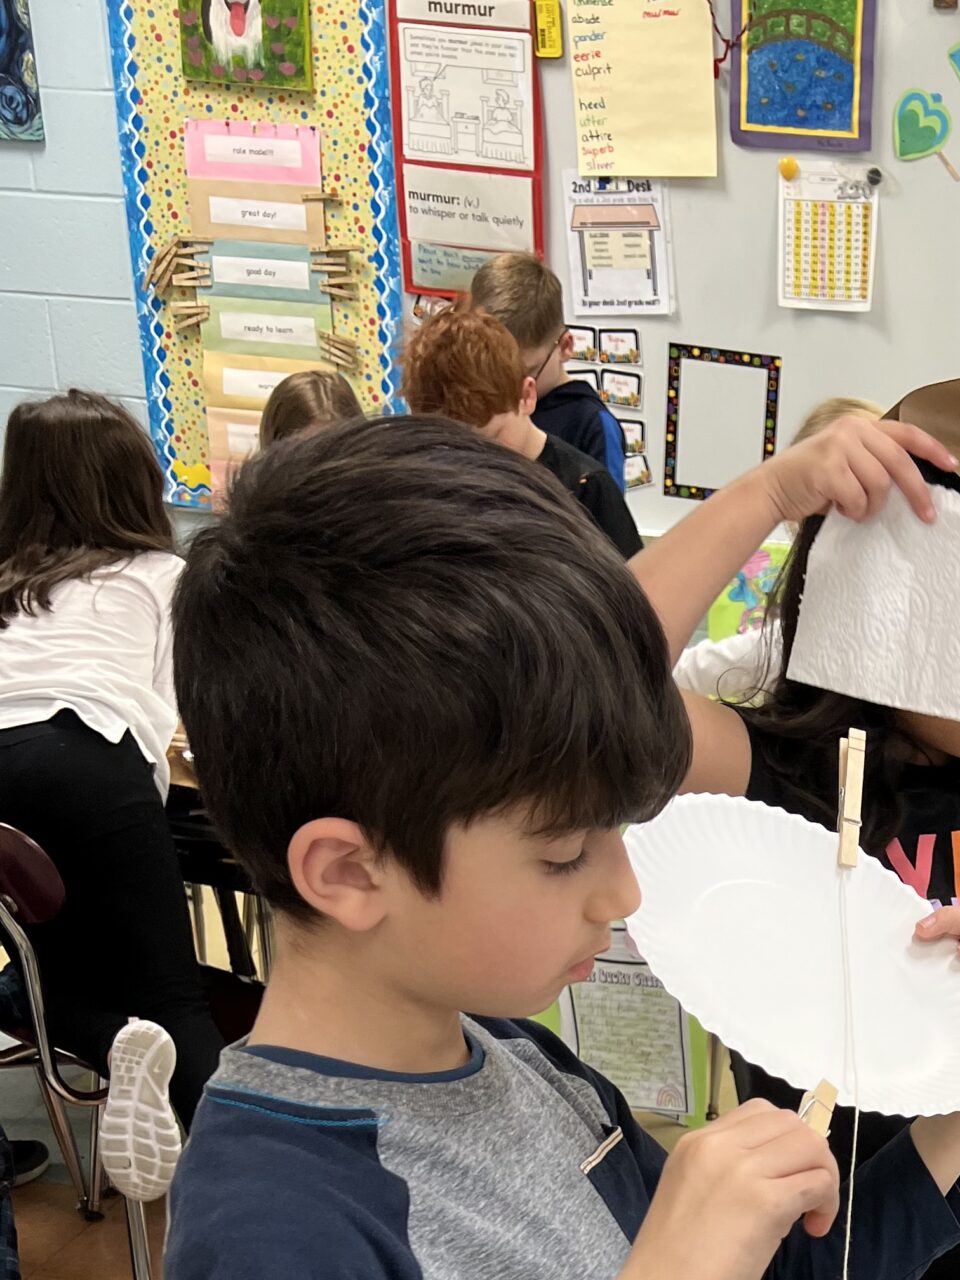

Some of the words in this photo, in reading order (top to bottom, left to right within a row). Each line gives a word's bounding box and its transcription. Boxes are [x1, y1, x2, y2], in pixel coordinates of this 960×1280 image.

[428, 0, 495, 17] murmur
[572, 13, 600, 24] abode
[573, 31, 607, 49] ponder
[573, 50, 602, 62] eerie
[575, 63, 612, 81] culprit
[579, 98, 606, 110] heed
[579, 116, 607, 128] utter
[581, 130, 613, 142] attire
[582, 144, 615, 157] superb
[572, 181, 591, 193] 2nd
[627, 180, 652, 192] Desk
[408, 190, 460, 205] murmur:
[241, 210, 260, 218] great
[262, 211, 277, 220] day!
[409, 205, 419, 214] to
[421, 205, 456, 220] whisper
[459, 212, 469, 220] or
[472, 212, 489, 222] talk
[492, 215, 524, 229] quietly
[246, 267, 261, 277] good
[263, 268, 277, 278] day
[244, 324, 263, 335] ready
[266, 325, 273, 334] to
[276, 325, 293, 334] learn
